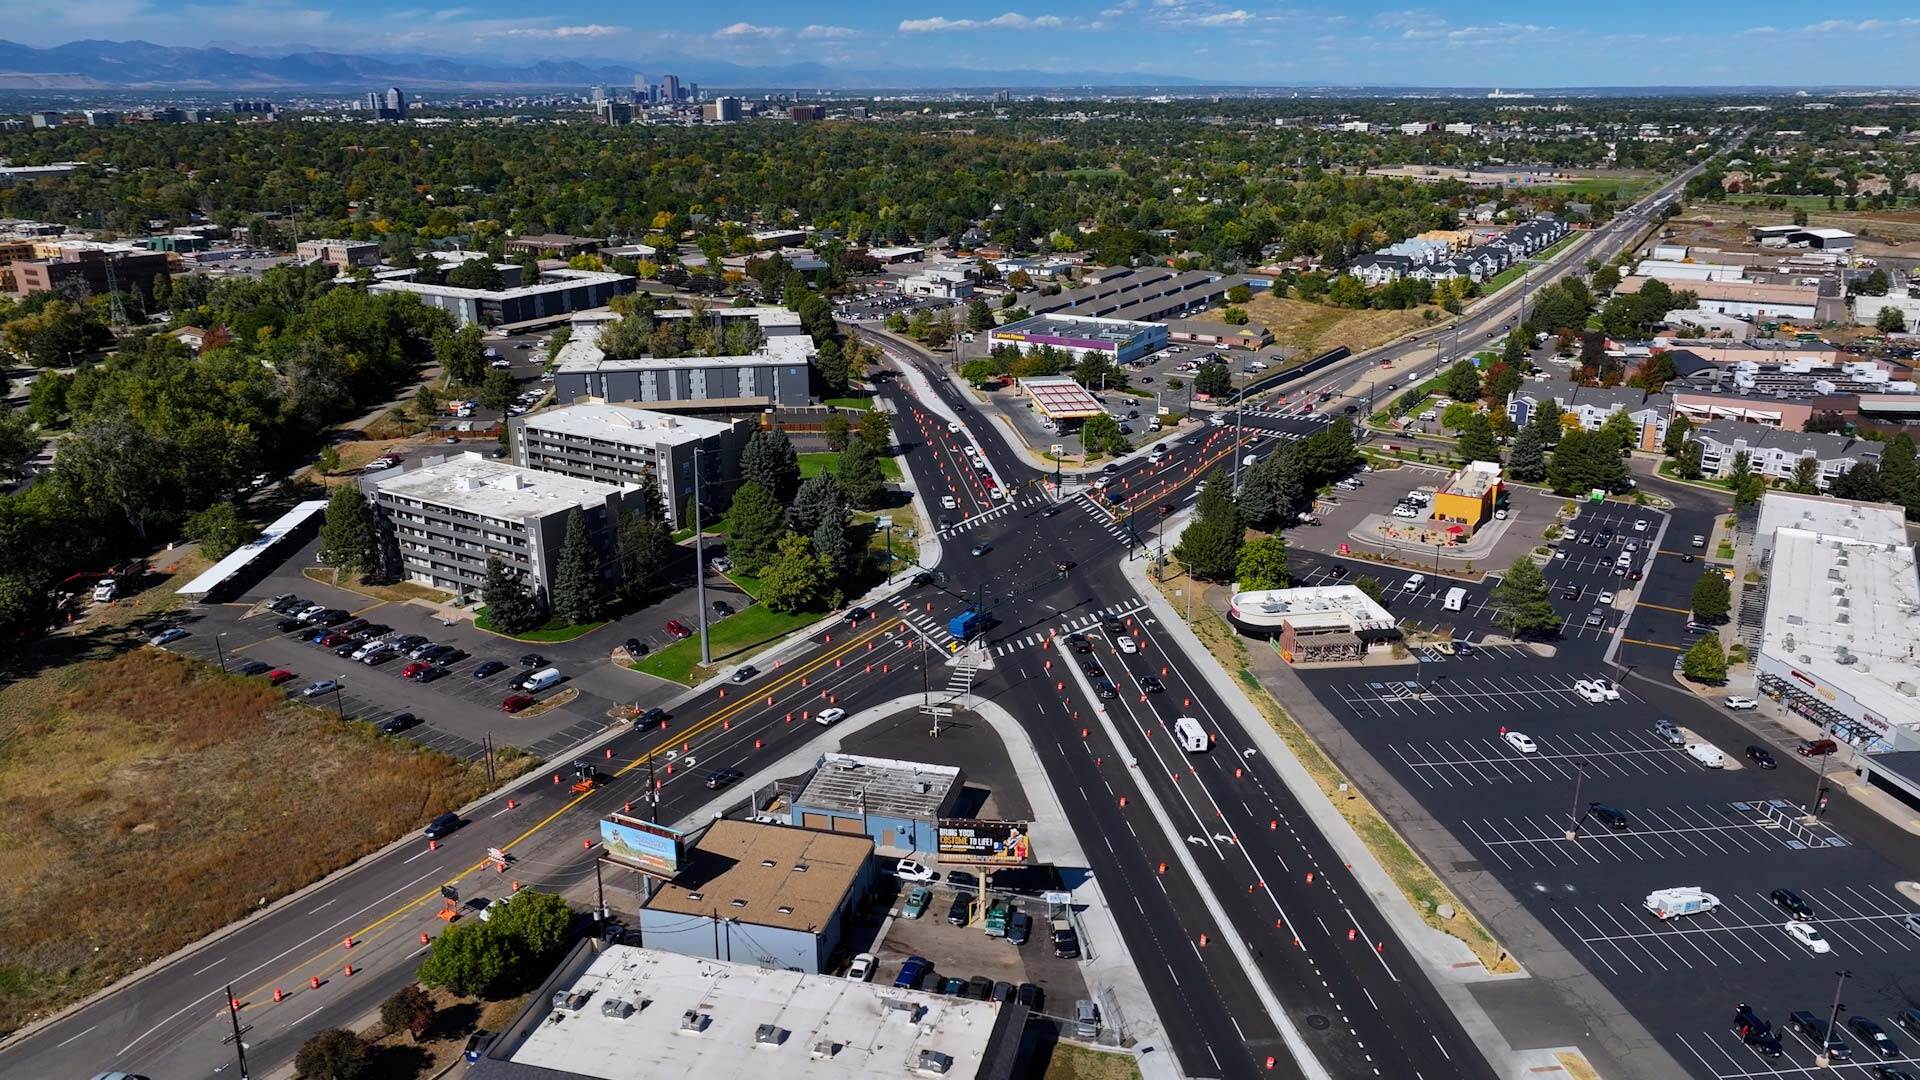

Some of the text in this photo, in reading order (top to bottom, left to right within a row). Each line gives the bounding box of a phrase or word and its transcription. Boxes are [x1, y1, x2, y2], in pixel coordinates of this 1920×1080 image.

[939, 828, 975, 837] BRING YOUR
[940, 836, 968, 845] COSTUME
[978, 838, 993, 846] LIFE!
